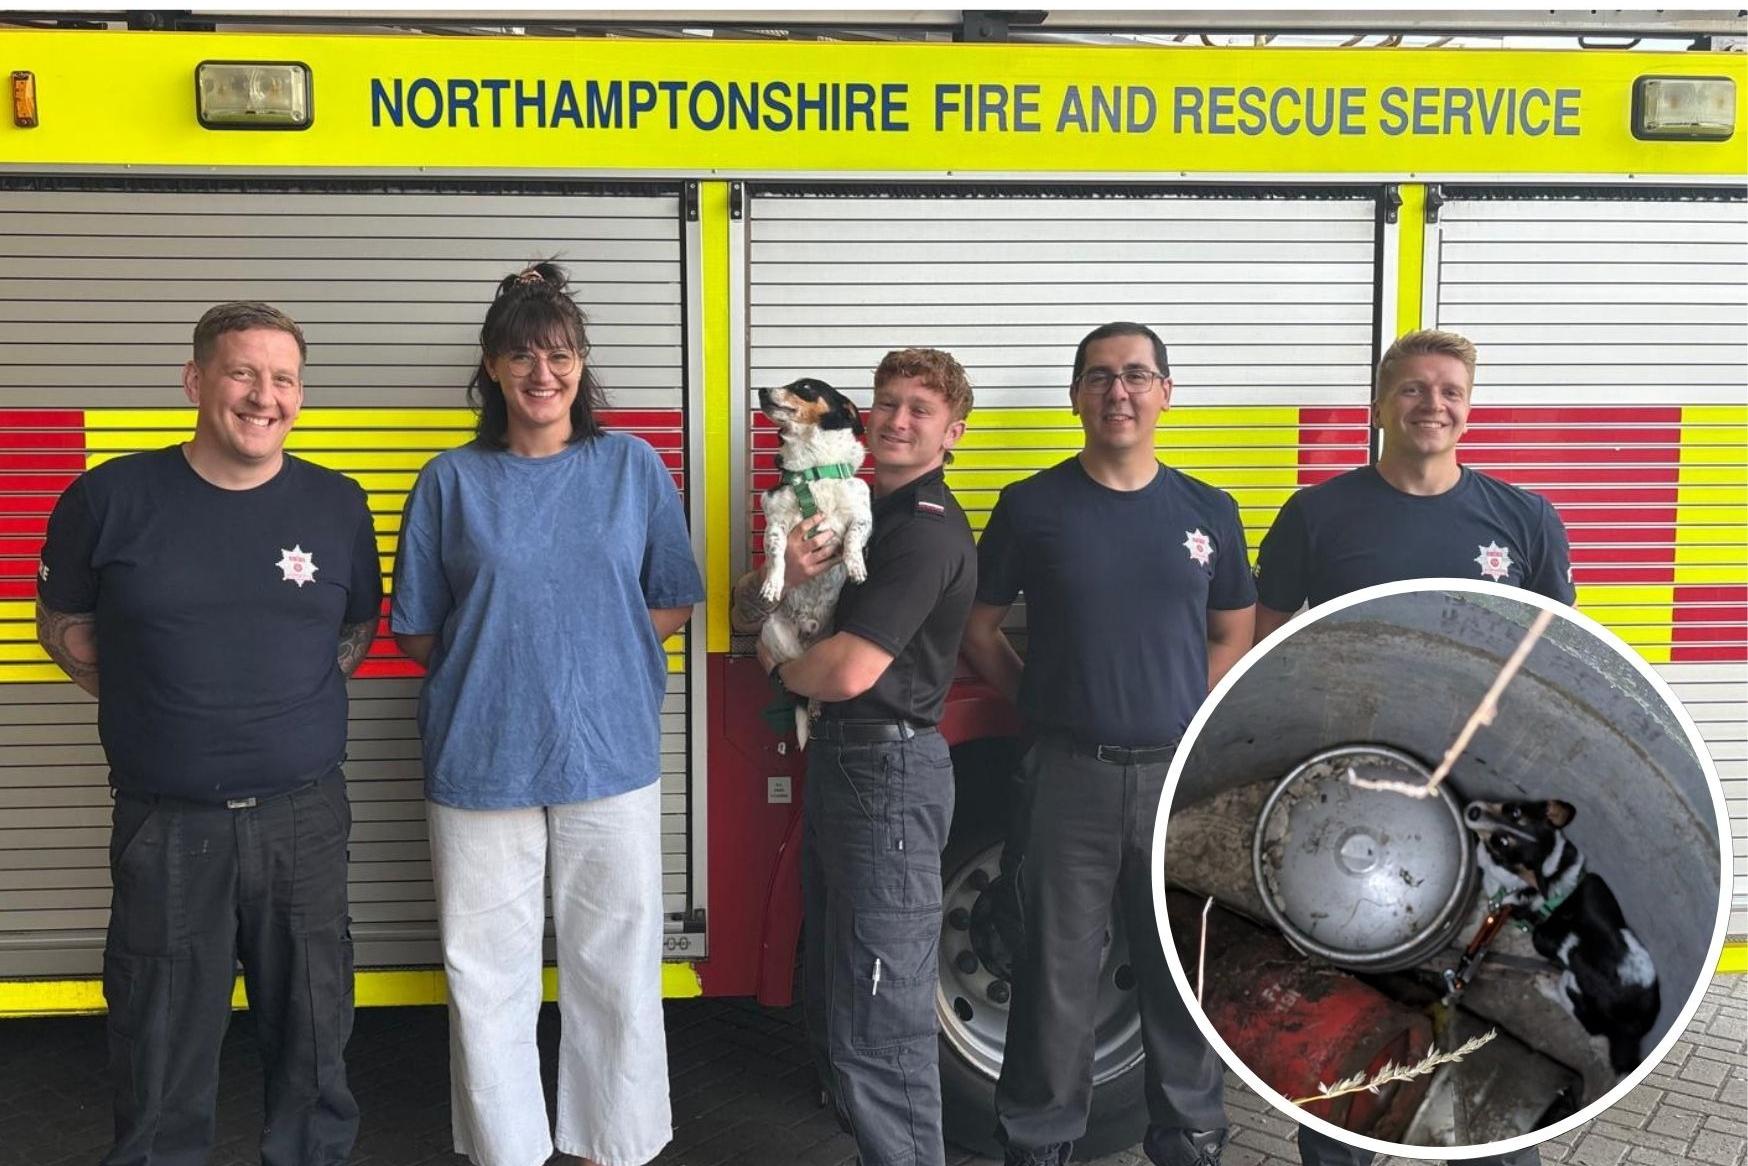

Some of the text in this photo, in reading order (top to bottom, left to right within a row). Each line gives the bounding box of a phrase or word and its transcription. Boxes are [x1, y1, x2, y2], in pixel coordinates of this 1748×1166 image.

[371, 78, 1581, 136] NORTHAMPTONSHIRE FIRE AND RESCUE SERVICE
